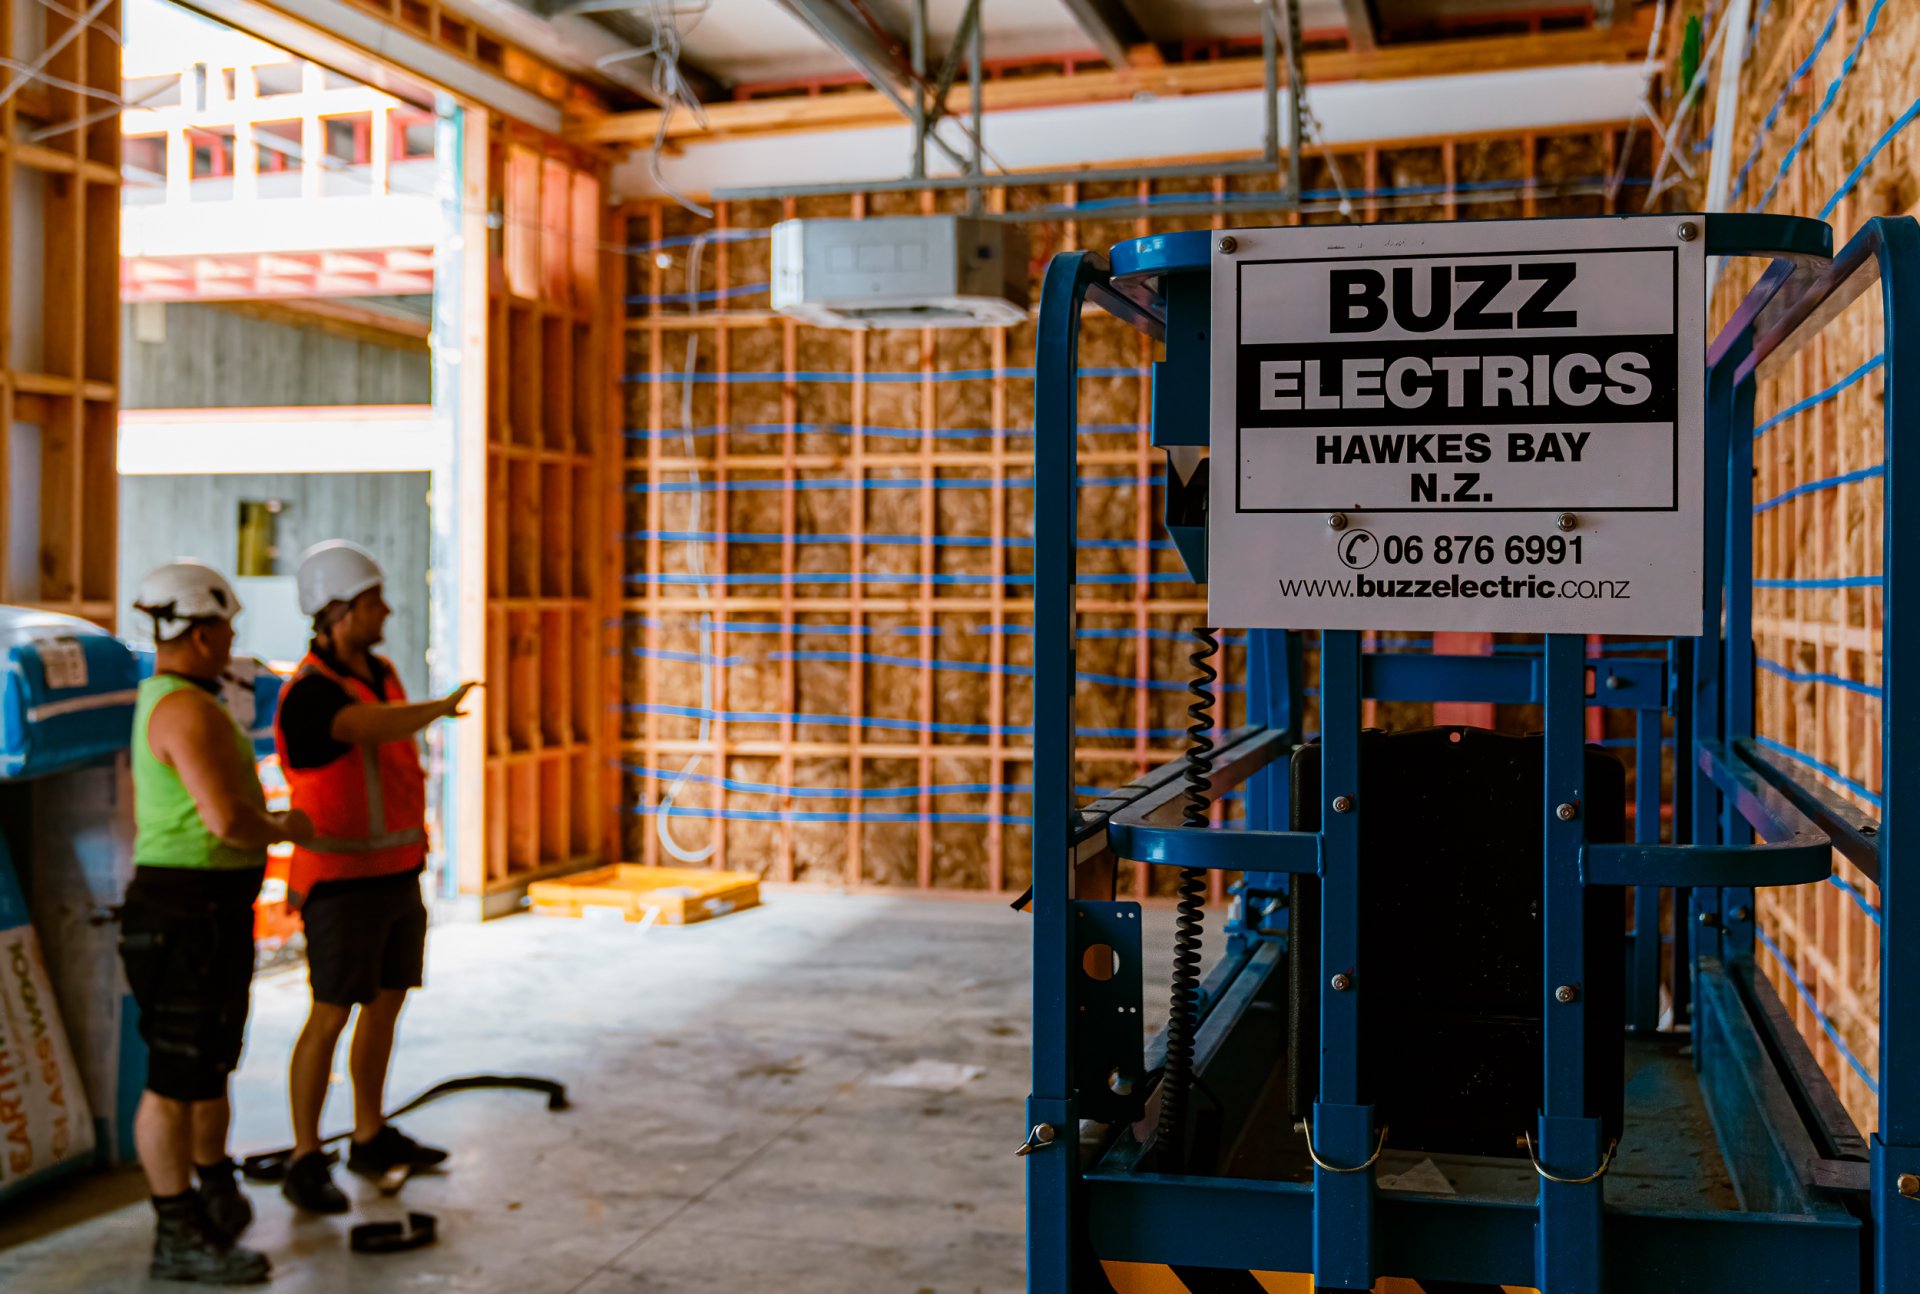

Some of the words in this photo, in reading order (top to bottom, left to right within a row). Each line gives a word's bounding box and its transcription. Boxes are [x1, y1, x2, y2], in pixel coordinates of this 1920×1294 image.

[1330, 262, 1577, 333] BUZZ
[1260, 351, 1652, 410] ELECTRICS
[1316, 434, 1491, 464] HAWKES
[1507, 432, 1590, 462] BAY
[1410, 473, 1493, 502] N.Z.
[1383, 535, 1423, 564] 06
[1433, 535, 1494, 565] 876
[1504, 535, 1582, 565] 6991
[1279, 574, 1631, 599] www.buzzelectric.co.nz
